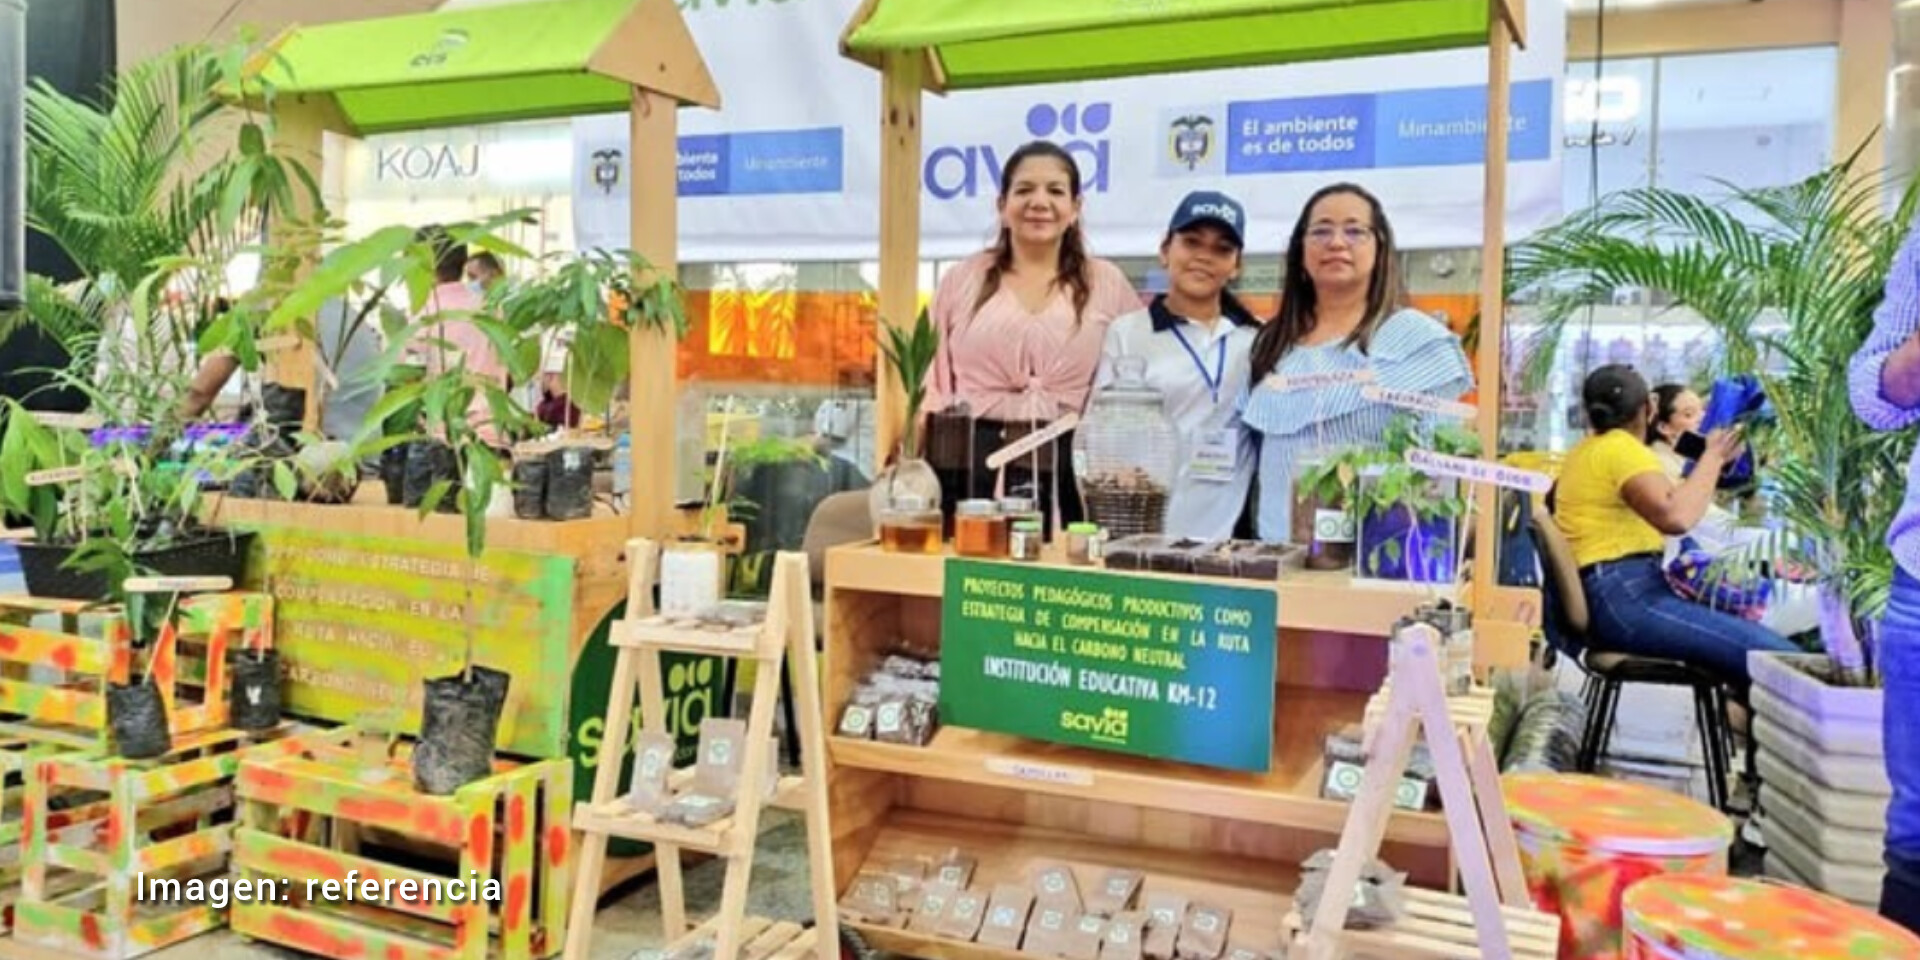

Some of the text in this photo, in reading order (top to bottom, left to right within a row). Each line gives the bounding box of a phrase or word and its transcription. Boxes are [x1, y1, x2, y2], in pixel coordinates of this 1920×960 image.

[1241, 114, 1358, 136] El ambiente
[377, 144, 479, 181] KOAJ
[1242, 134, 1355, 156] es de todos
[678, 169, 716, 182] todos
[963, 577, 1252, 628] PROYECTOS PEDAGÓGICOS PRODUCTIVOS COMO
[961, 600, 1250, 653] ESTRATEGIA DE COMPENSACIÓN EN LA RUTA
[1013, 630, 1187, 670] HACIA EL CARBONO NEUTRAL
[983, 655, 1218, 711] INSTITUCIÓN EDUCATIVA KM-12
[1060, 709, 1128, 738] savia
